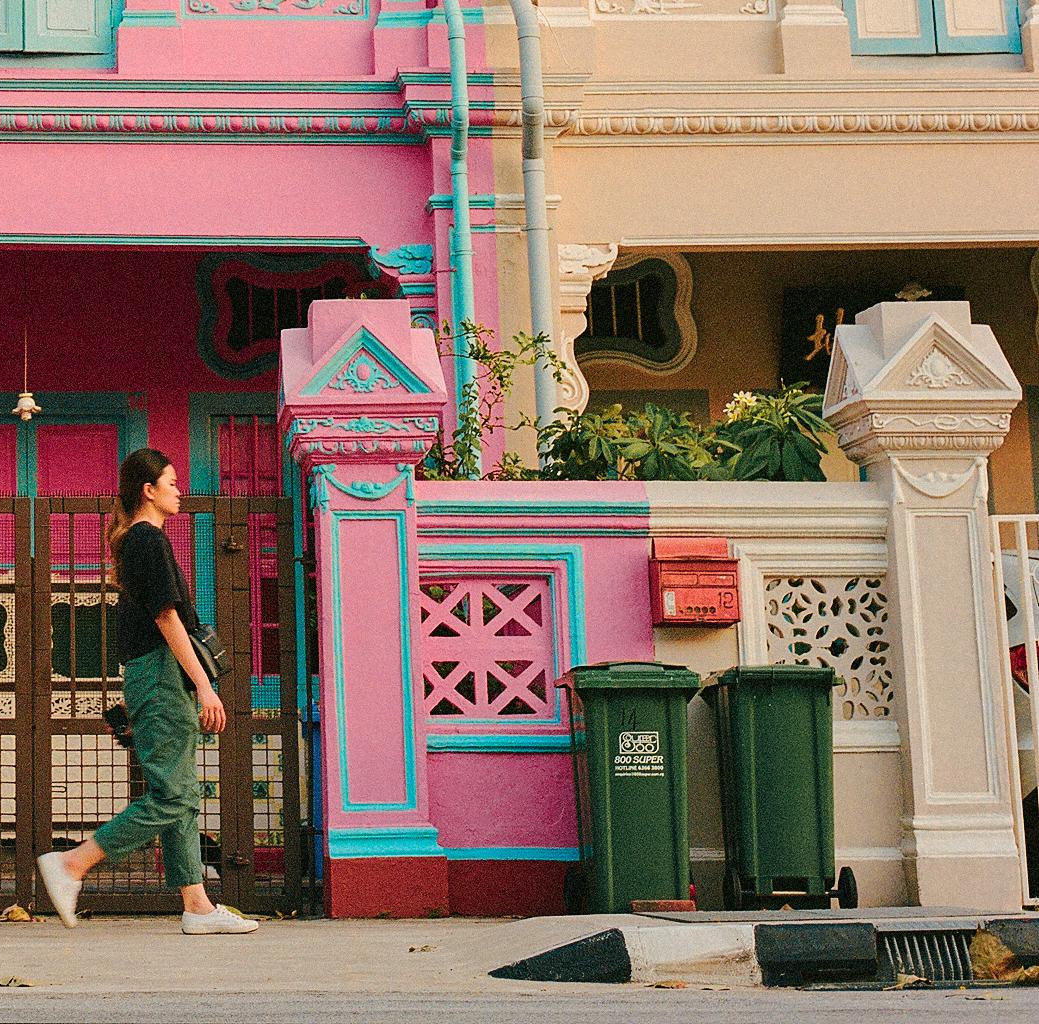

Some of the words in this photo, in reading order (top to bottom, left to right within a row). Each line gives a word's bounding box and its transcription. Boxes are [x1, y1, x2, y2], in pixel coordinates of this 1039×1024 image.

[718, 592, 734, 609] 12
[614, 756, 632, 764] 800
[632, 756, 664, 764] SUPER
